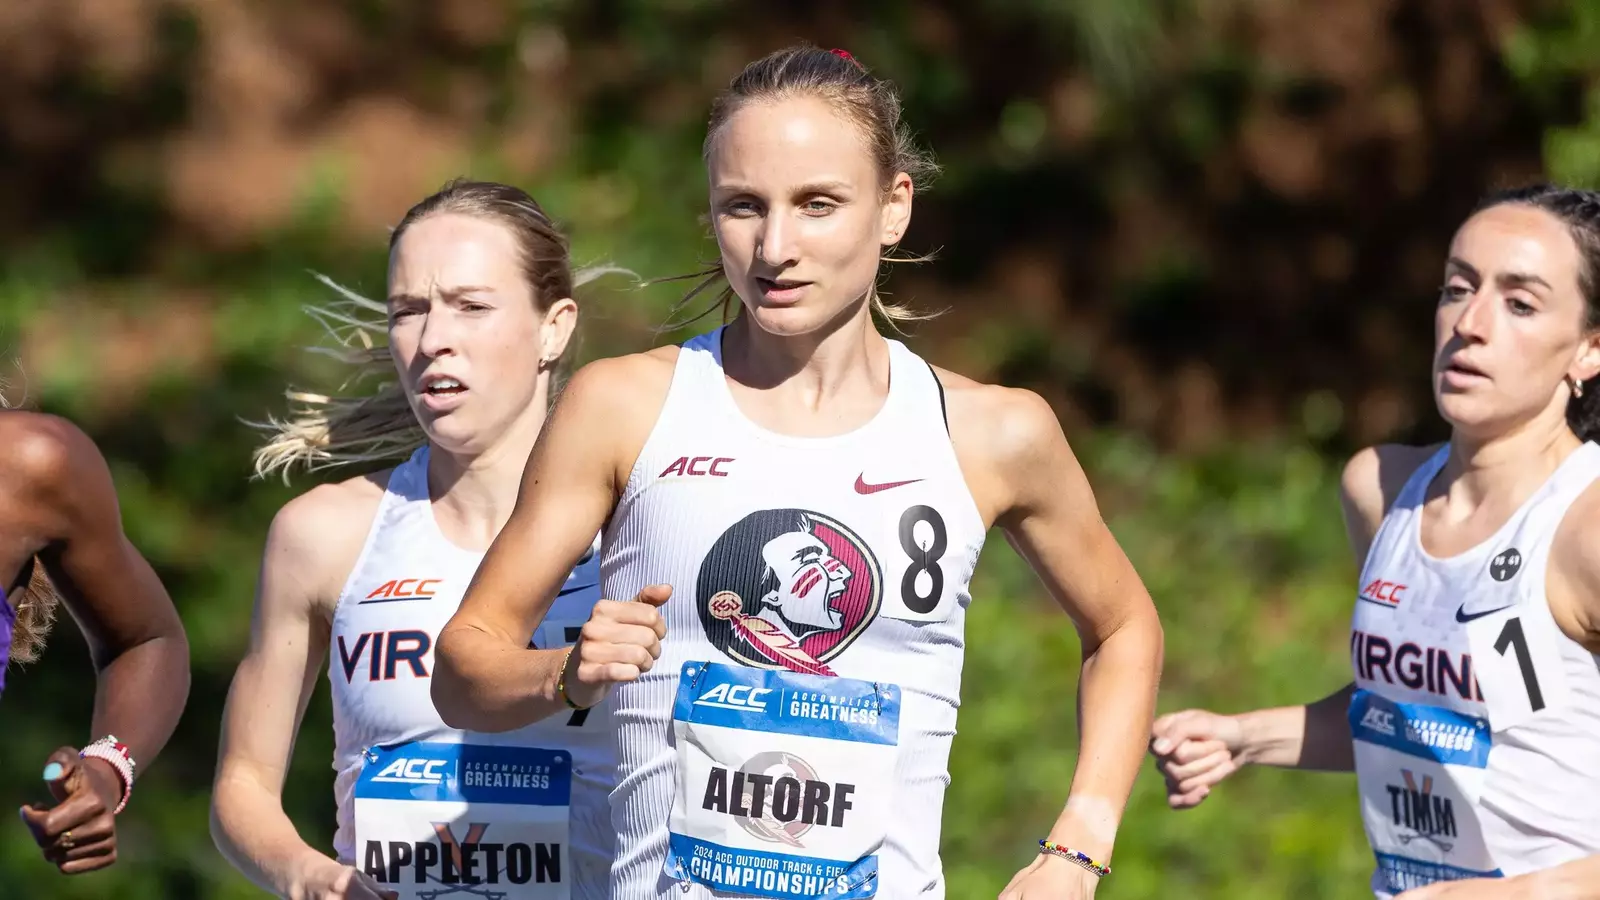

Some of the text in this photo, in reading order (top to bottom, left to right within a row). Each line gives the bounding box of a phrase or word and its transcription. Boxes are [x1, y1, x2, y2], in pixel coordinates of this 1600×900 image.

[658, 456, 736, 478] ACC
[898, 504, 948, 614] 8
[366, 578, 444, 599] ACC
[1363, 578, 1409, 604] ACC
[1493, 616, 1546, 713] 1
[700, 683, 773, 706] ACC
[789, 701, 878, 725] GREATNESS
[1361, 707, 1395, 731] ACC
[376, 758, 448, 780] ACC
[464, 770, 550, 790] GREATNESS
[465, 762, 550, 774] ACCOMPLISH
[702, 766, 855, 828] ALTORF
[1386, 784, 1458, 838] TIMM
[363, 839, 562, 884] APPLETON
[693, 844, 714, 859] 2024
[714, 851, 733, 864] ACC
[735, 854, 779, 870] OUTDOOR
[783, 860, 812, 875] TRACK
[816, 865, 823, 875] &
[690, 856, 850, 896] CHAMPIONSHIPS
